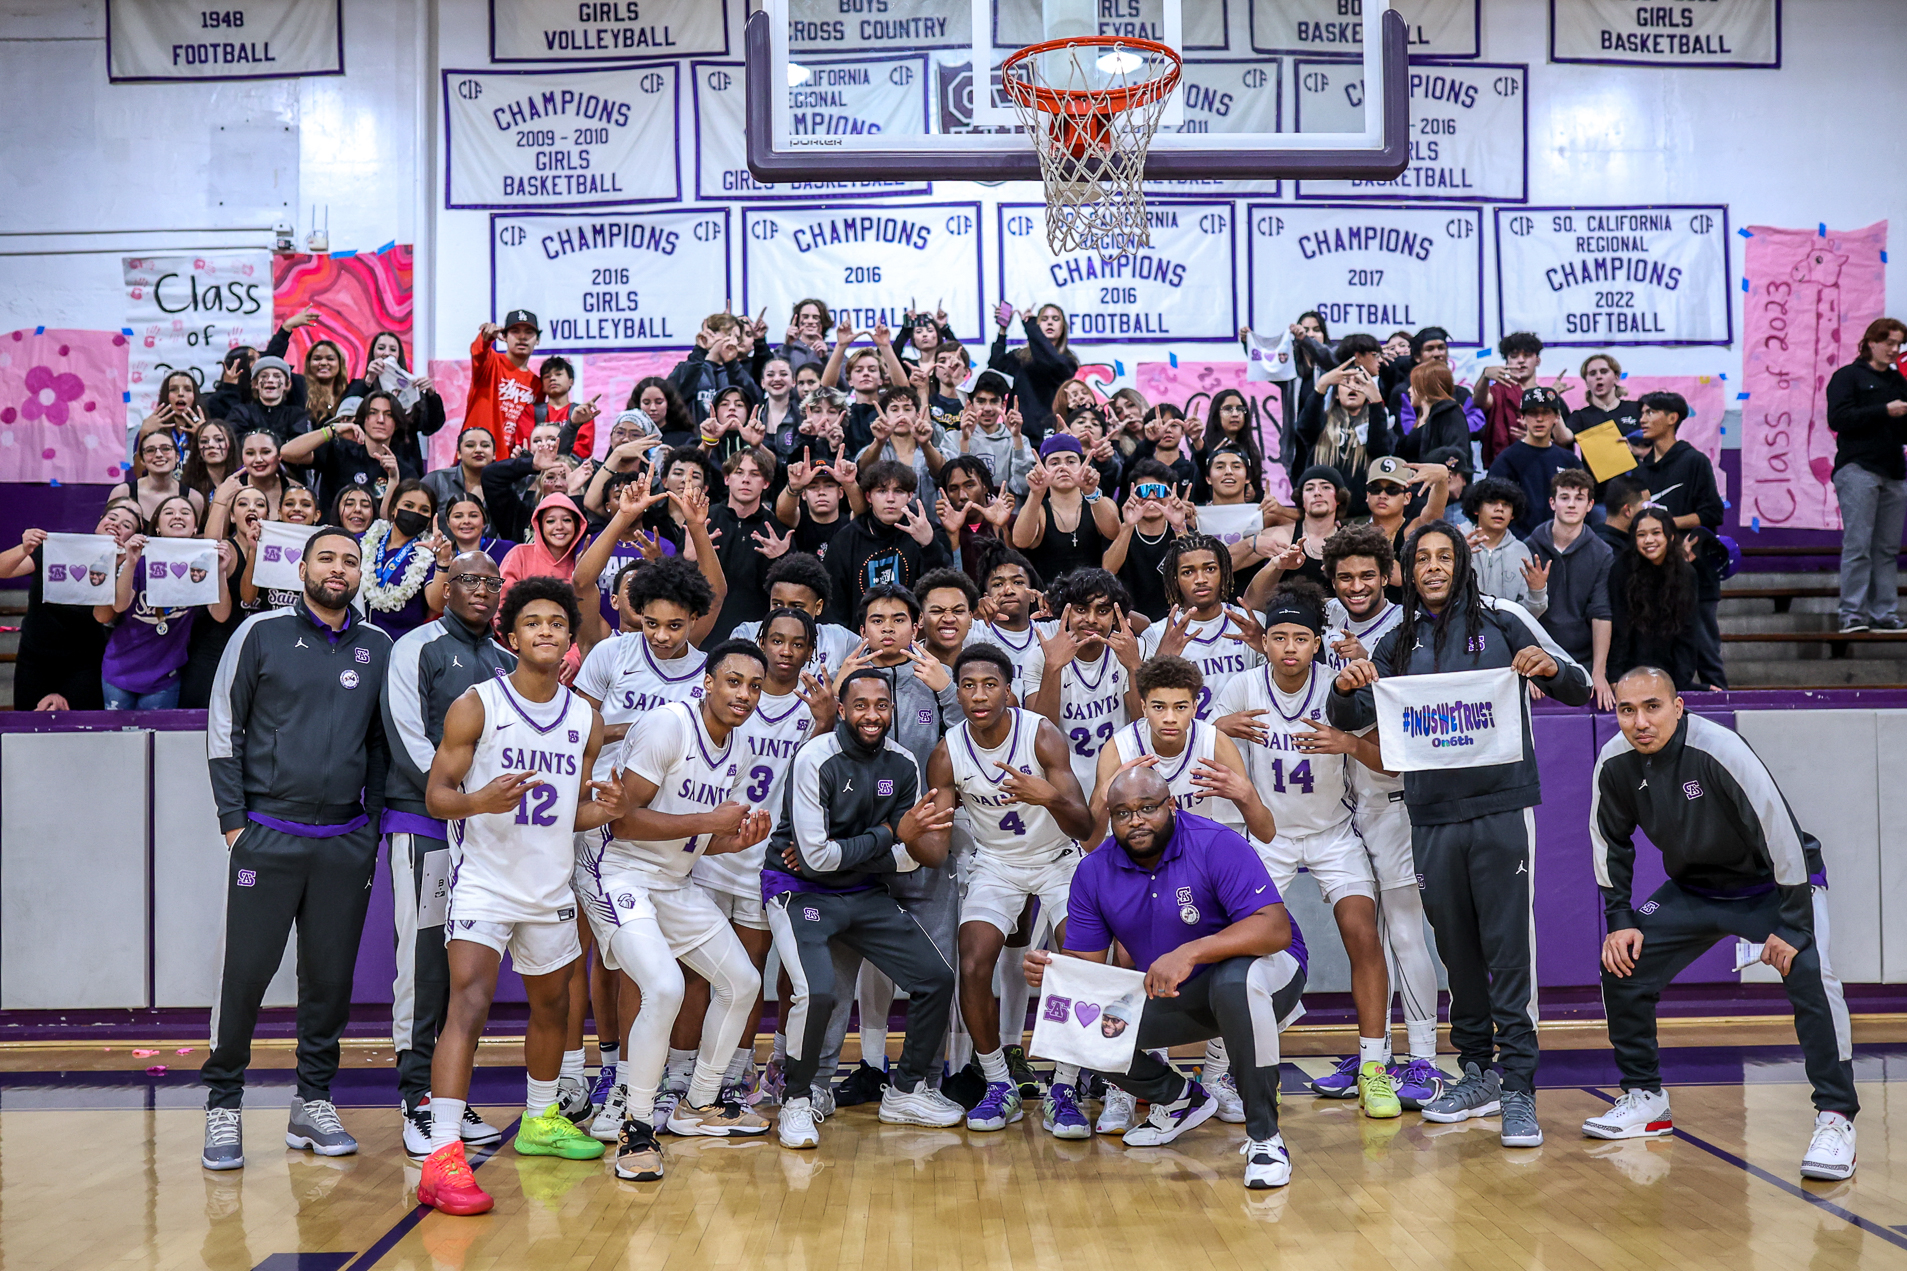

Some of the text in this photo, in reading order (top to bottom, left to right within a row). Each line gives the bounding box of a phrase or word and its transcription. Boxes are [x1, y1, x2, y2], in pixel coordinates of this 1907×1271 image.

[201, 10, 244, 29] 1948
[579, 1, 639, 23] GIRLS
[1636, 6, 1693, 28] GIRLS
[543, 25, 677, 51] VOLLEYBALL
[788, 14, 951, 44] ROSS COUNTRY
[172, 41, 276, 66] FOOTBALL
[1600, 29, 1732, 55] BASKETBALL
[493, 89, 631, 135] CHAMPIONS
[789, 91, 848, 110] EGIONAL
[516, 129, 555, 148] 2009
[573, 127, 609, 146] 2010
[1420, 117, 1456, 135] 2016
[535, 149, 590, 171] GIRLS
[503, 172, 623, 196] BASKETBALL
[793, 216, 931, 253] CHAMPIONS
[1552, 214, 1672, 233] SO. CALIFORNIA
[541, 222, 680, 260] CHAMPIONS
[1298, 226, 1434, 262] CHAMPIONS
[1576, 235, 1649, 253] REGIONAL
[592, 268, 630, 286] 2016
[844, 266, 881, 284] 2016
[1049, 253, 1188, 290] CHAMPIONS
[1348, 269, 1384, 287] 2017
[1545, 256, 1682, 295] CHAMPIONS
[153, 272, 264, 316] Class
[583, 290, 638, 313] GIRLS
[1100, 287, 1137, 304] 2016
[1595, 291, 1634, 309] 2022
[1068, 311, 1171, 335] FOOTBALL
[1317, 303, 1416, 327] SOFTBALL
[1566, 312, 1666, 334] SOFTBALL
[1764, 280, 1792, 352] 2023
[186, 325, 217, 347] of
[549, 317, 673, 341] VOLLEYBALL
[1766, 364, 1791, 390] of
[1754, 411, 1797, 524] Class
[1062, 692, 1120, 721] SAINTS
[748, 735, 805, 760] AINTS
[501, 746, 577, 776] SAINTS
[746, 764, 775, 804] 3
[1271, 757, 1315, 794] 14
[514, 783, 559, 827] 12
[998, 810, 1026, 836] 4
